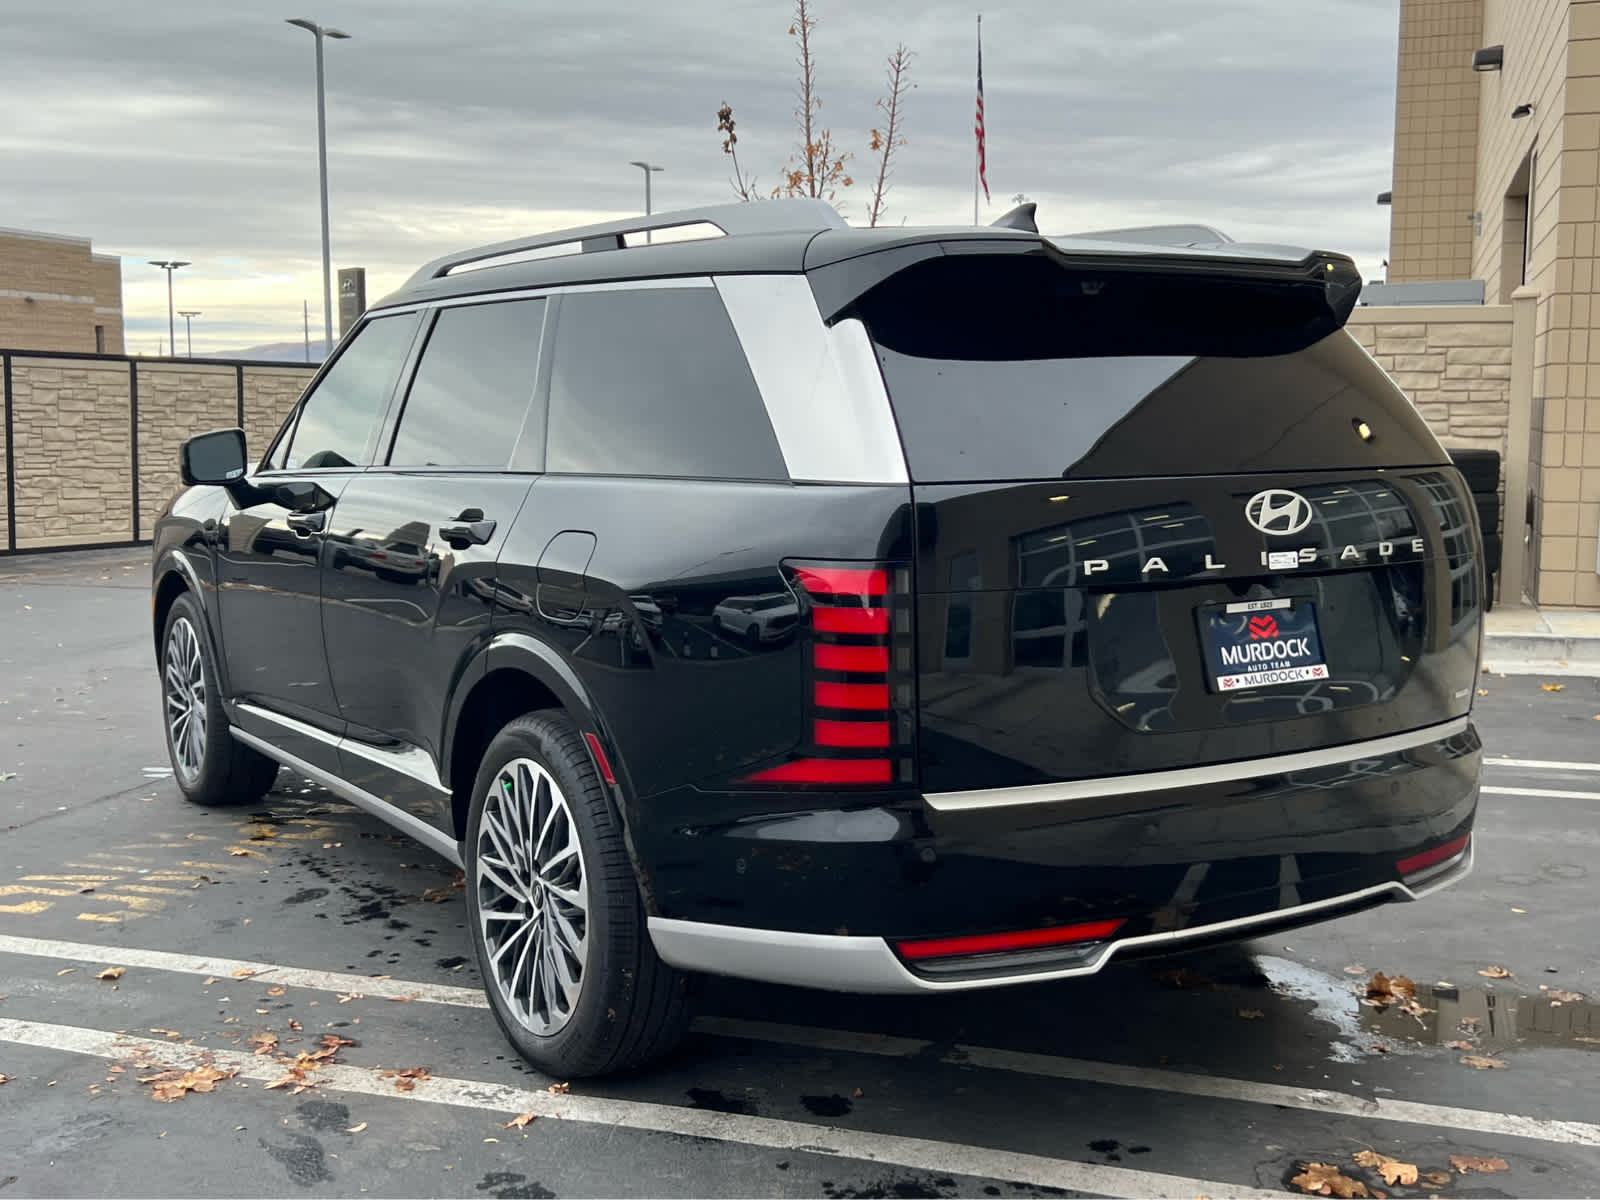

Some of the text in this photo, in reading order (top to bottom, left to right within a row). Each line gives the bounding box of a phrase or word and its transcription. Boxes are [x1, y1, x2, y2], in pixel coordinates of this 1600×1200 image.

[1084, 538, 1425, 576] PALISADE
[1221, 638, 1311, 665] MURDOCK
[1244, 669, 1304, 686] MURDOCK
[1247, 661, 1291, 672] AUTO TEAM
